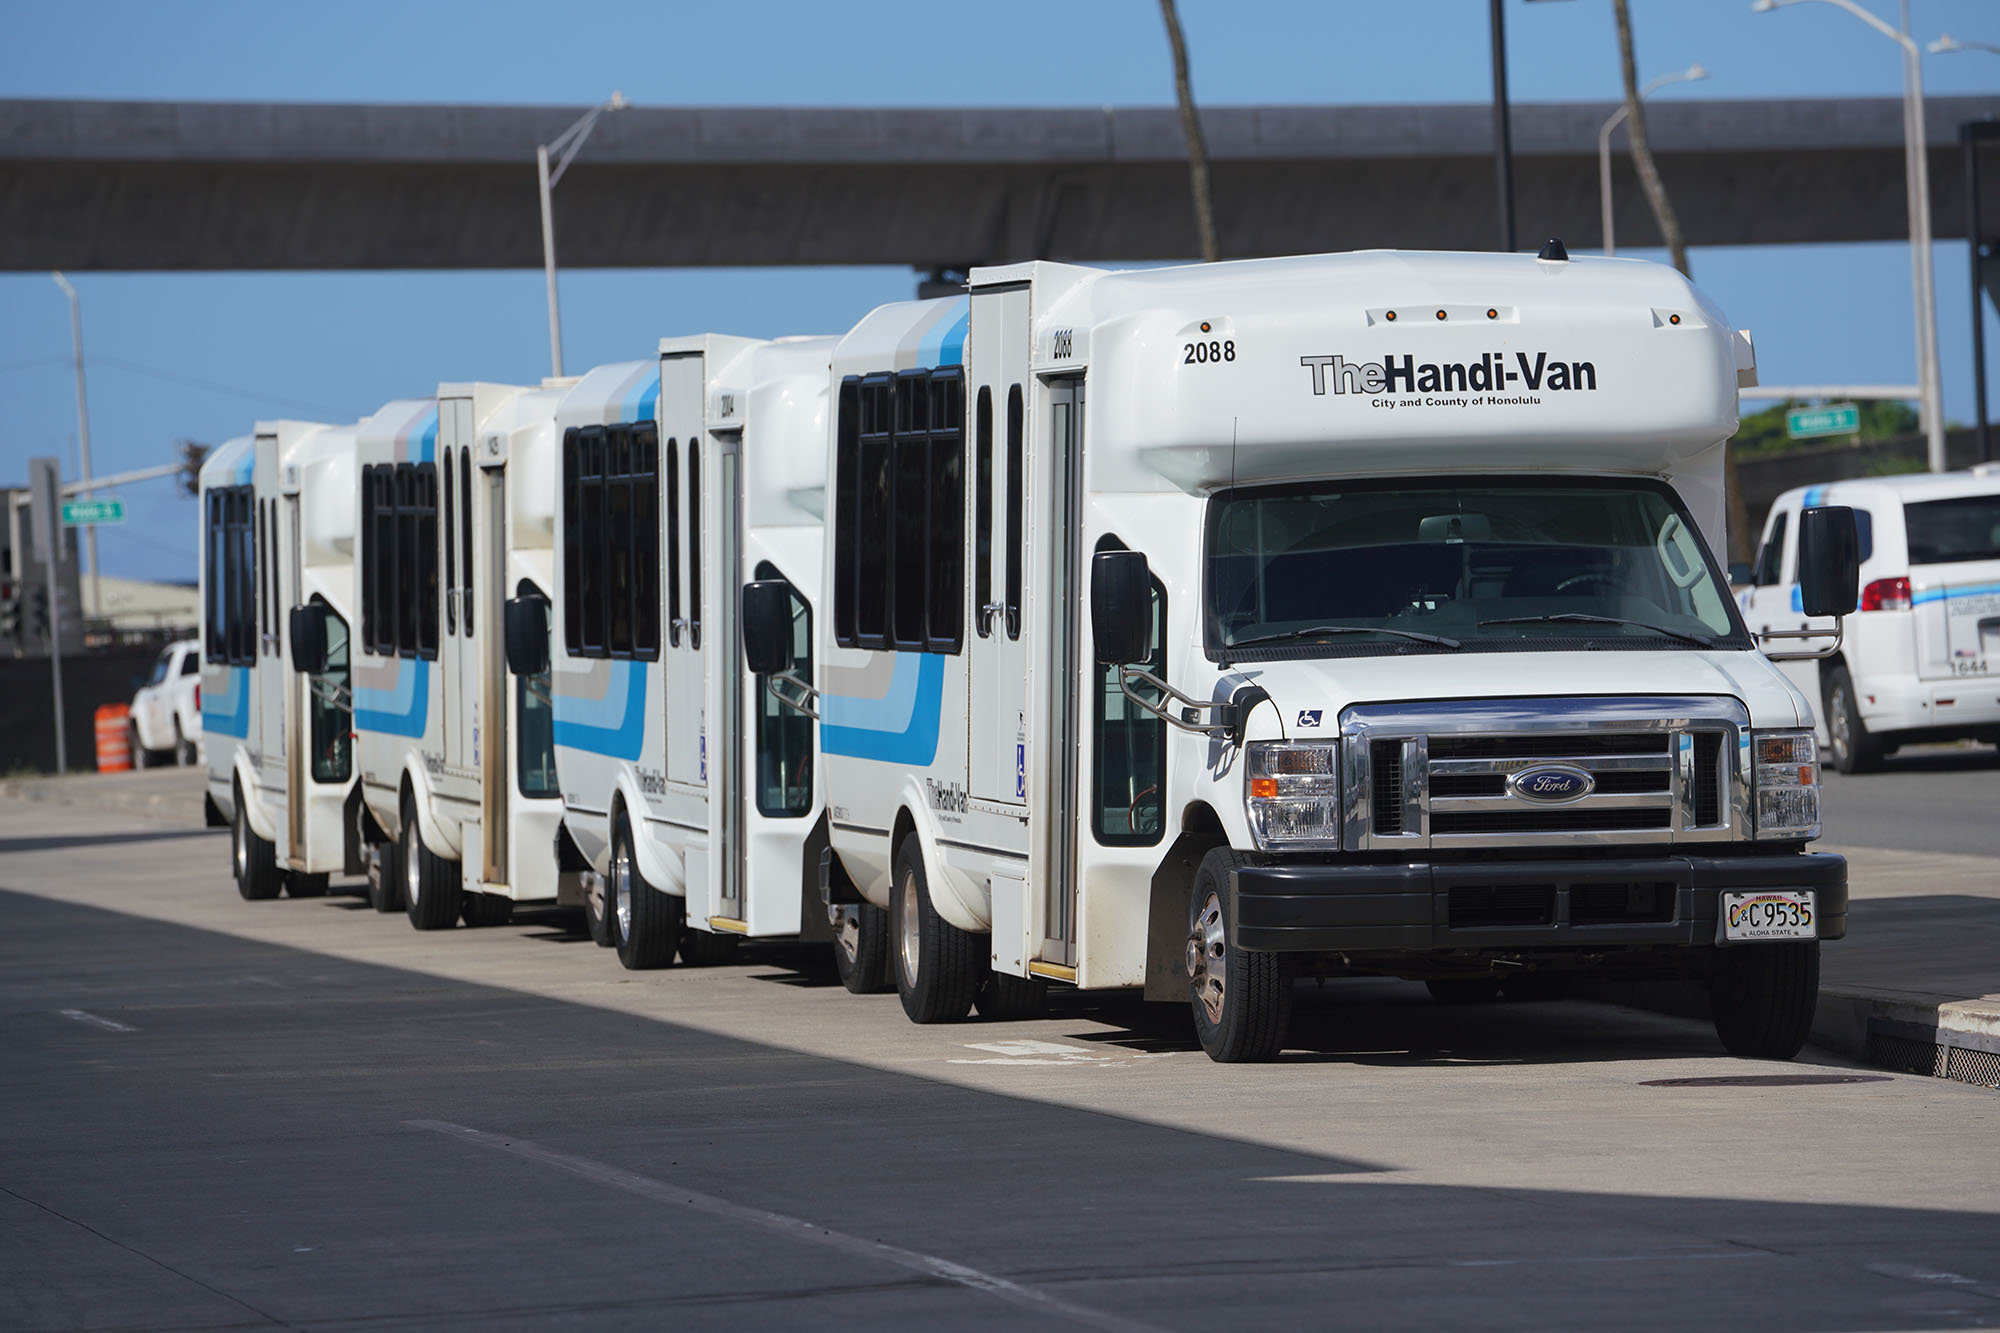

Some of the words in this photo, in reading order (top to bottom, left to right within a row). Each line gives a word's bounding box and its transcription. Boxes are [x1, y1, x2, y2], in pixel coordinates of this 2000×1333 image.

[1054, 329, 1072, 359] 2088
[1184, 340, 1236, 364] 2088
[1300, 351, 1597, 395] TheHandi-Van
[1371, 399, 1396, 409] City
[1400, 398, 1422, 407] and
[1425, 397, 1468, 408] County
[1472, 396, 1484, 405] of
[1488, 396, 1541, 405] Honolulu
[1533, 776, 1571, 791] Ford
[1729, 903, 1760, 927] C&C
[1764, 902, 1811, 927] 9535
